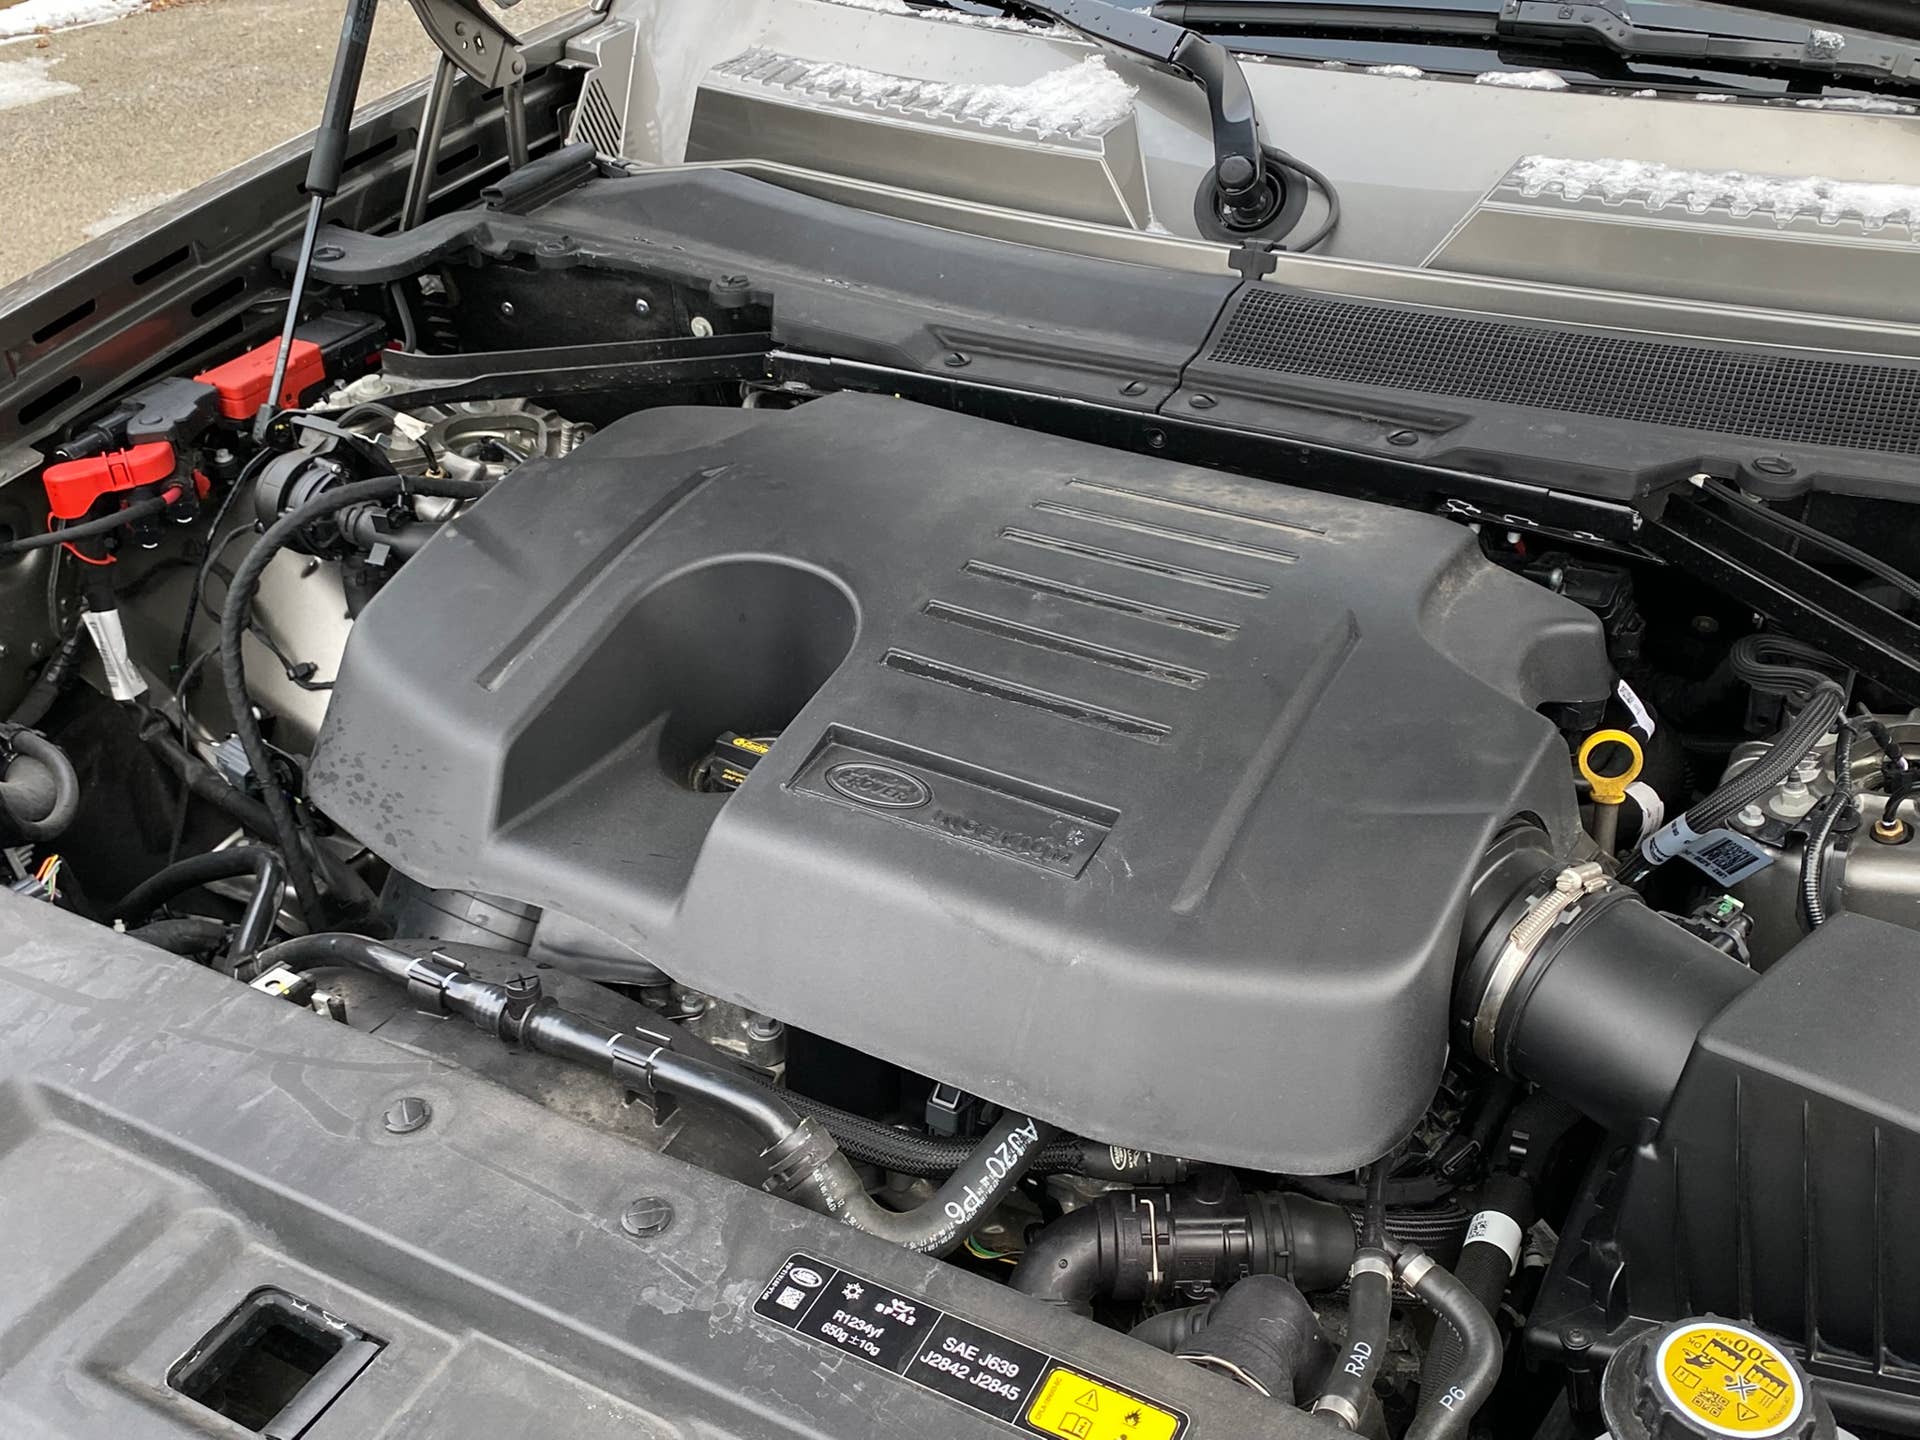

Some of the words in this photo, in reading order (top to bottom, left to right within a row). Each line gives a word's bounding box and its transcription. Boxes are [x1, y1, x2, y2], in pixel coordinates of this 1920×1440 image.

[821, 1322, 848, 1343] 650g
[832, 1309, 885, 1338] R1234yf
[942, 1337, 980, 1361] SAE
[978, 1353, 1019, 1378] J639
[1344, 1341, 1372, 1378] RAD
[1733, 1339, 1777, 1369] 200
[920, 1350, 970, 1379] J2842
[969, 1372, 1021, 1400] J2845
[1439, 1385, 1466, 1412] P6
